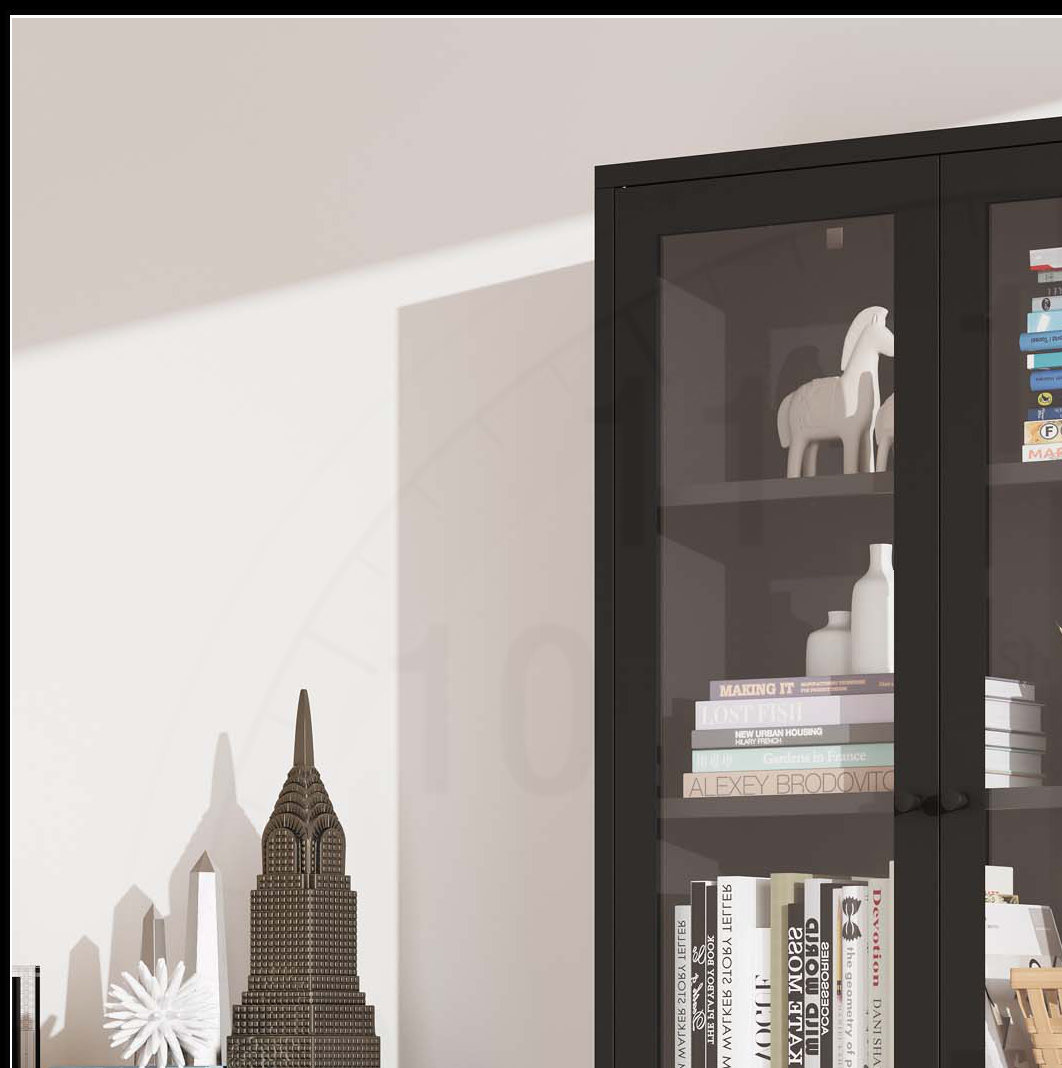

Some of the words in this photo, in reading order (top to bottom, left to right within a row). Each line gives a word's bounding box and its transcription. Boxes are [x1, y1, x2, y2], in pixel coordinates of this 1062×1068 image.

[719, 682, 776, 698] MAKING
[779, 681, 795, 695] IT
[702, 703, 753, 725] LOST
[756, 702, 803, 724] FISH
[735, 730, 753, 739] NEW
[755, 729, 784, 738] URBAN
[785, 727, 823, 738] HOUSING
[735, 738, 756, 746] HILARY
[757, 737, 782, 745] FRENCH
[763, 752, 811, 765] Gardens
[813, 752, 824, 763] in
[827, 751, 867, 763] France
[688, 775, 770, 798] ALEXEY
[872, 889, 882, 987] Devotion
[847, 946, 855, 968] the
[845, 972, 855, 1038] geometry
[872, 999, 882, 1034] DANI
[847, 1041, 855, 1055] of
